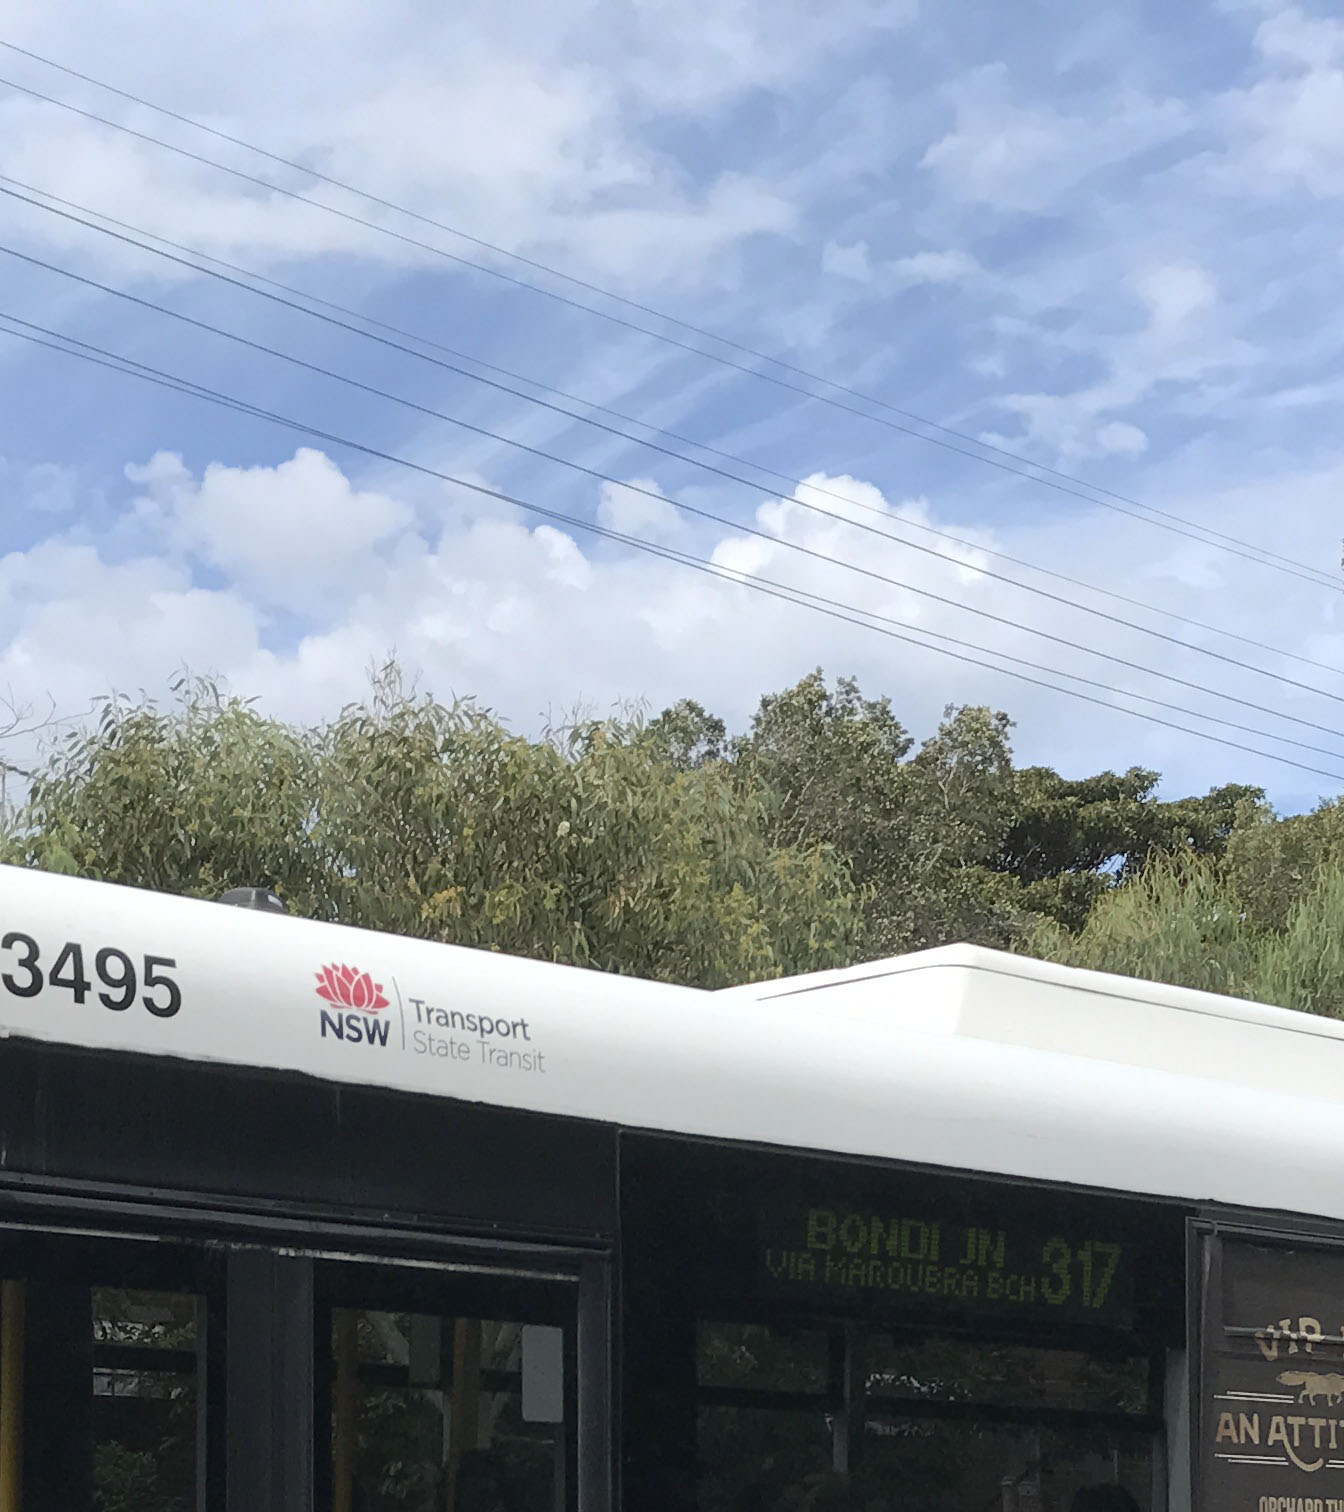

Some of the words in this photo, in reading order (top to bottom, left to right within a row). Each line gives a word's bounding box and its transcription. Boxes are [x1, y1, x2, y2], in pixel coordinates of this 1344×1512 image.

[1, 931, 182, 1018] 3495
[320, 1009, 391, 1047] NSW
[408, 998, 531, 1041] Transport
[413, 1030, 471, 1061] State
[477, 1040, 546, 1073] Transit
[808, 1207, 940, 1262] BONDI
[959, 1226, 1006, 1268] JN
[765, 1249, 816, 1281] VIA
[987, 1271, 1036, 1301] BCH
[1040, 1236, 1121, 1309] 317
[1255, 1317, 1323, 1361] VIP
[1216, 1412, 1260, 1445] AN
